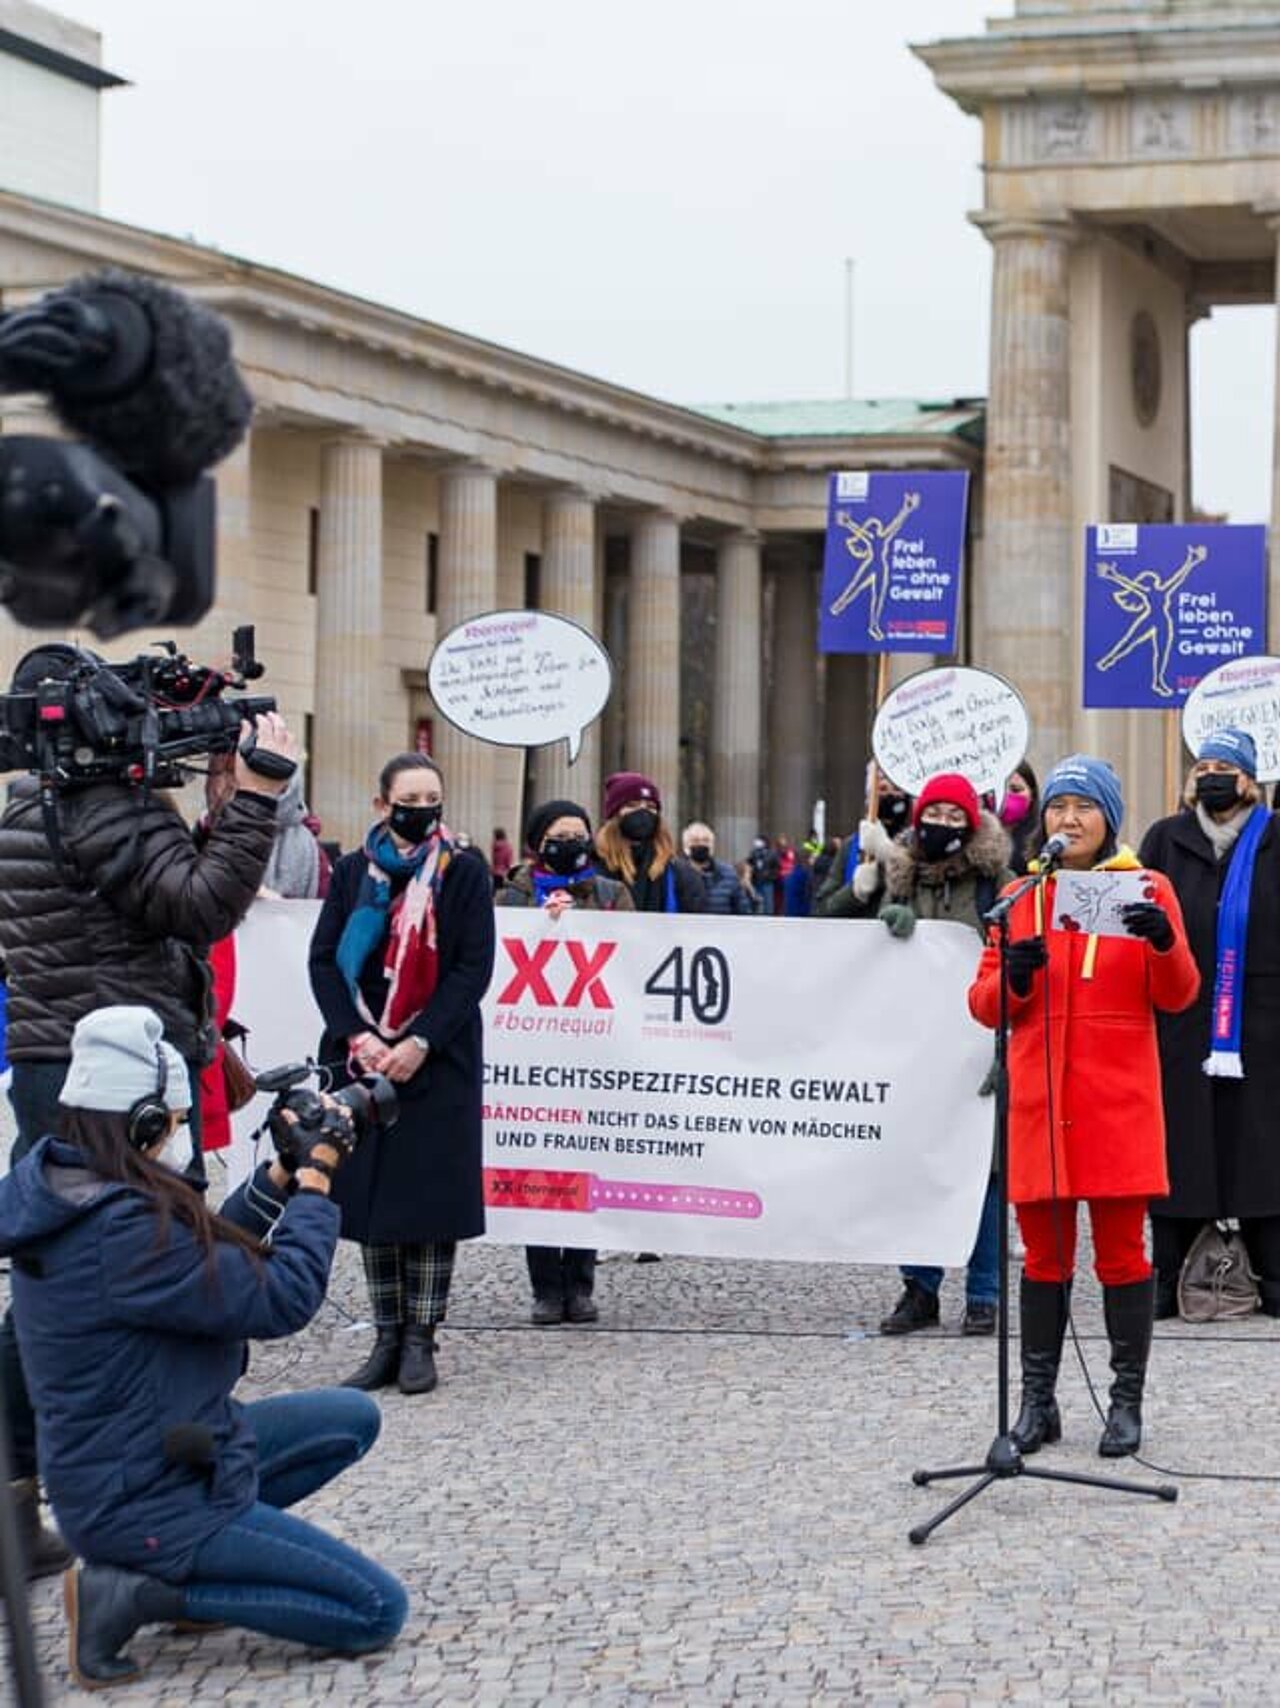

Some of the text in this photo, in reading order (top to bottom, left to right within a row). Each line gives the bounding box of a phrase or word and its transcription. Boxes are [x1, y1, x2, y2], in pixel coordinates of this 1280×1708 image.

[893, 539, 923, 554] Frei
[892, 555, 936, 569] leben
[910, 570, 950, 585] ohne
[890, 586, 944, 600] Gewalt
[1178, 592, 1216, 607] Frei
[1178, 609, 1233, 623] leben
[1202, 625, 1253, 638] ohne
[1178, 640, 1245, 655] Gewalt
[496, 937, 619, 1009] XX
[493, 1011, 614, 1038] #bornequal
[790, 1079, 890, 1103] GEWALT
[587, 1110, 640, 1128] NICHT
[644, 1113, 679, 1130] DAS
[685, 1115, 742, 1134] LEBEN
[749, 1118, 787, 1135] VON
[792, 1117, 882, 1140] MÄDCHEN
[495, 1131, 705, 1158] UND FRAUEN BESTIMMT
